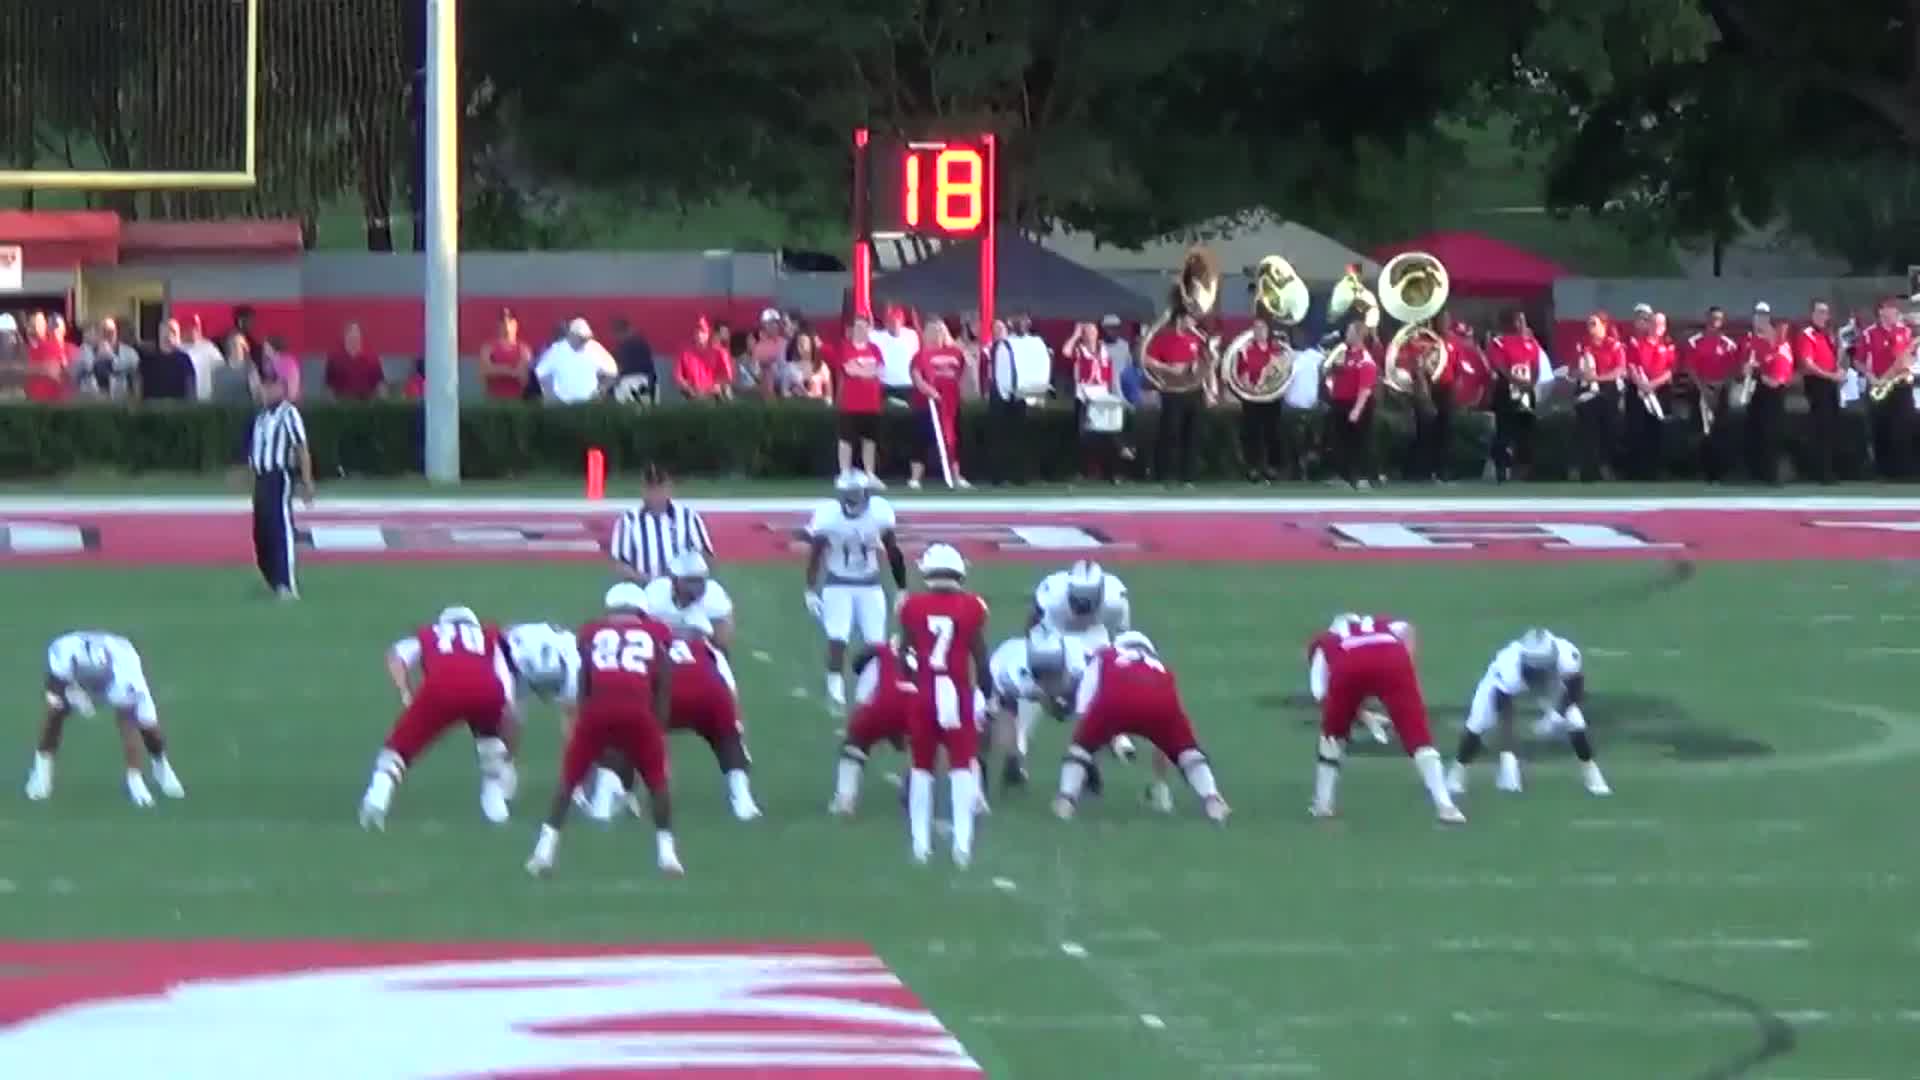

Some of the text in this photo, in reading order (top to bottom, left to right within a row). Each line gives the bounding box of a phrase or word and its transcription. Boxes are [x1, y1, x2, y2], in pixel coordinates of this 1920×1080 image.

[906, 150, 982, 230] 18
[592, 629, 655, 674] 82
[926, 614, 953, 672] 7
